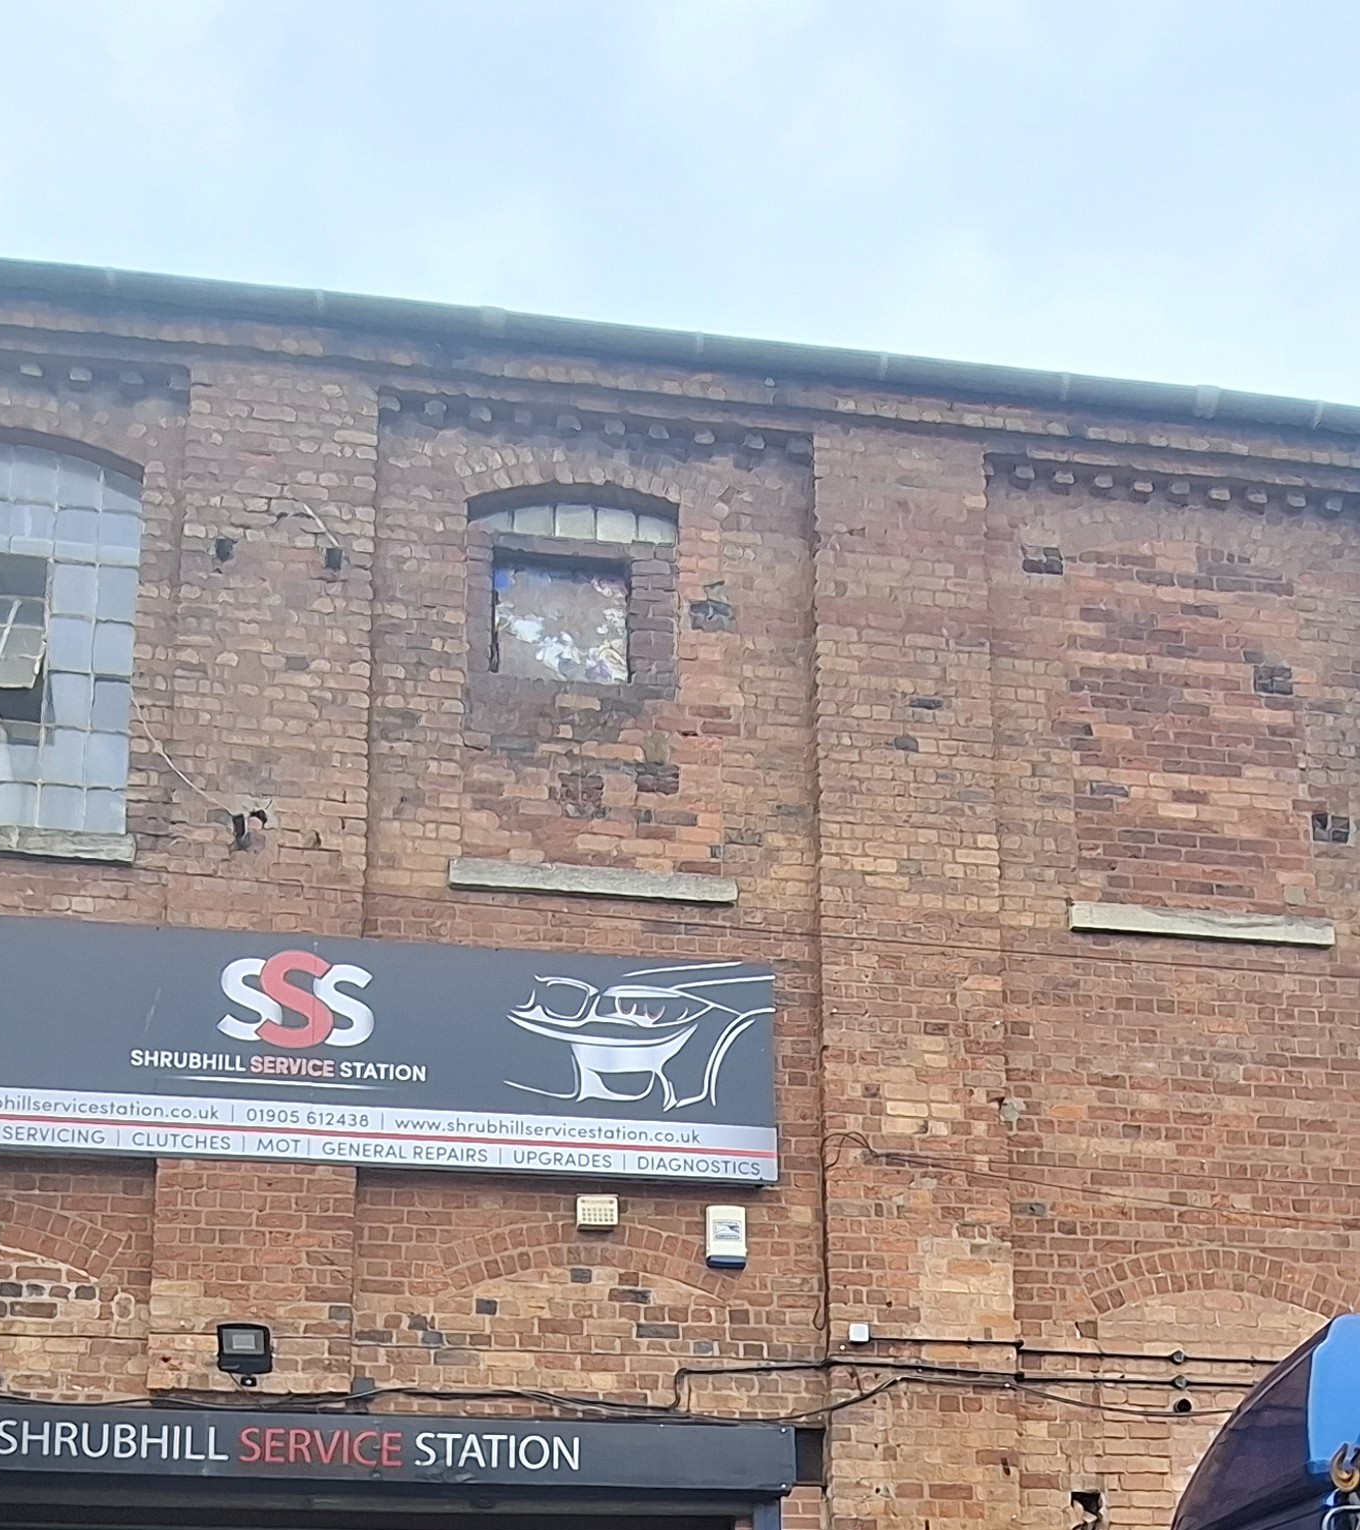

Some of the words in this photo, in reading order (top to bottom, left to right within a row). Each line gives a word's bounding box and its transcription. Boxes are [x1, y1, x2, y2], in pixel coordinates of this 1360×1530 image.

[216, 950, 375, 1049] SSS
[130, 1049, 245, 1073] SHRUBHILL
[249, 1055, 334, 1079] SERVICE
[340, 1061, 427, 1083] STATION
[246, 1107, 299, 1124] 01905
[306, 1110, 370, 1128] 612438
[395, 1116, 701, 1145] www.shrubhillservicestation.co.uk
[1, 1125, 106, 1145] SERVICING
[131, 1132, 231, 1151] CLUTCHES
[256, 1138, 301, 1154] MOT
[322, 1141, 407, 1159] GENERAL
[413, 1145, 488, 1163] REPAIRS
[513, 1150, 612, 1169] UPGRADES
[637, 1155, 761, 1176] DIAGNOSTICS
[238, 1426, 404, 1468] SERVICE
[414, 1431, 580, 1471] STATION
